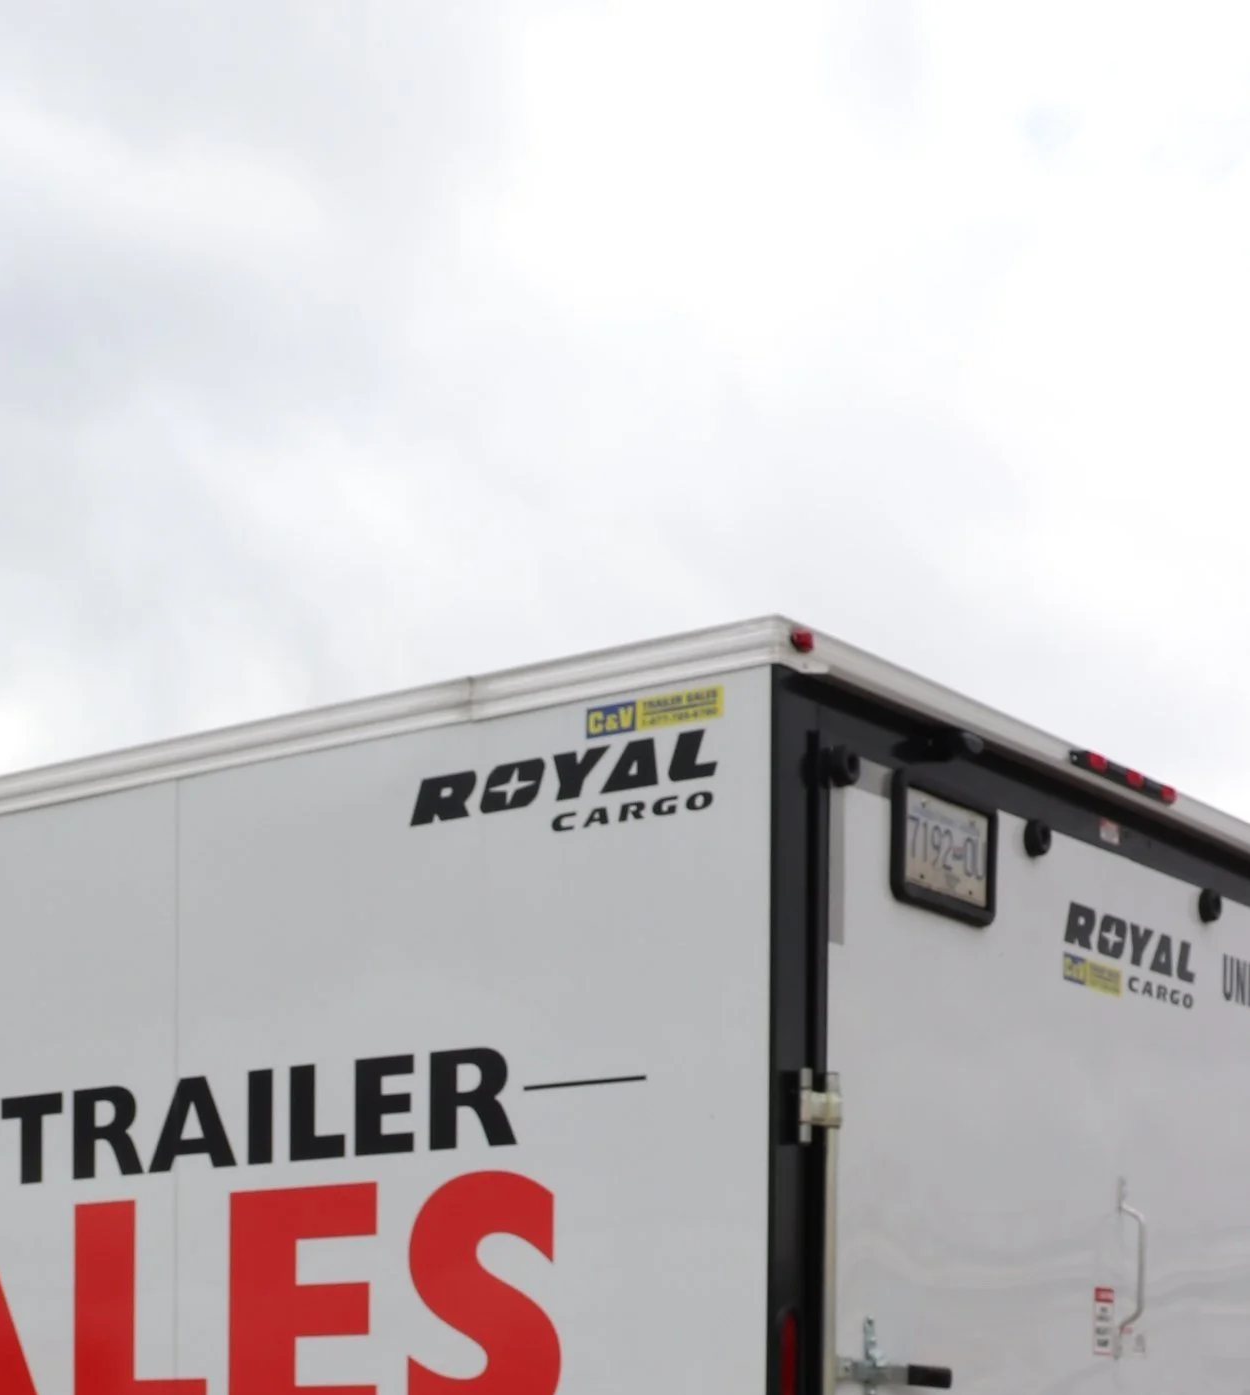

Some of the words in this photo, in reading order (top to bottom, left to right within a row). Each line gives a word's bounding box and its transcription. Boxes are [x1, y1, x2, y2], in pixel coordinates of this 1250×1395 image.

[588, 705, 633, 734] C&V
[410, 729, 717, 826] ROYAL
[552, 792, 714, 832] CARGO
[1064, 900, 1195, 983] ROYAL
[1128, 976, 1194, 1009] CARGO
[1, 1047, 518, 1186] TRAILER
